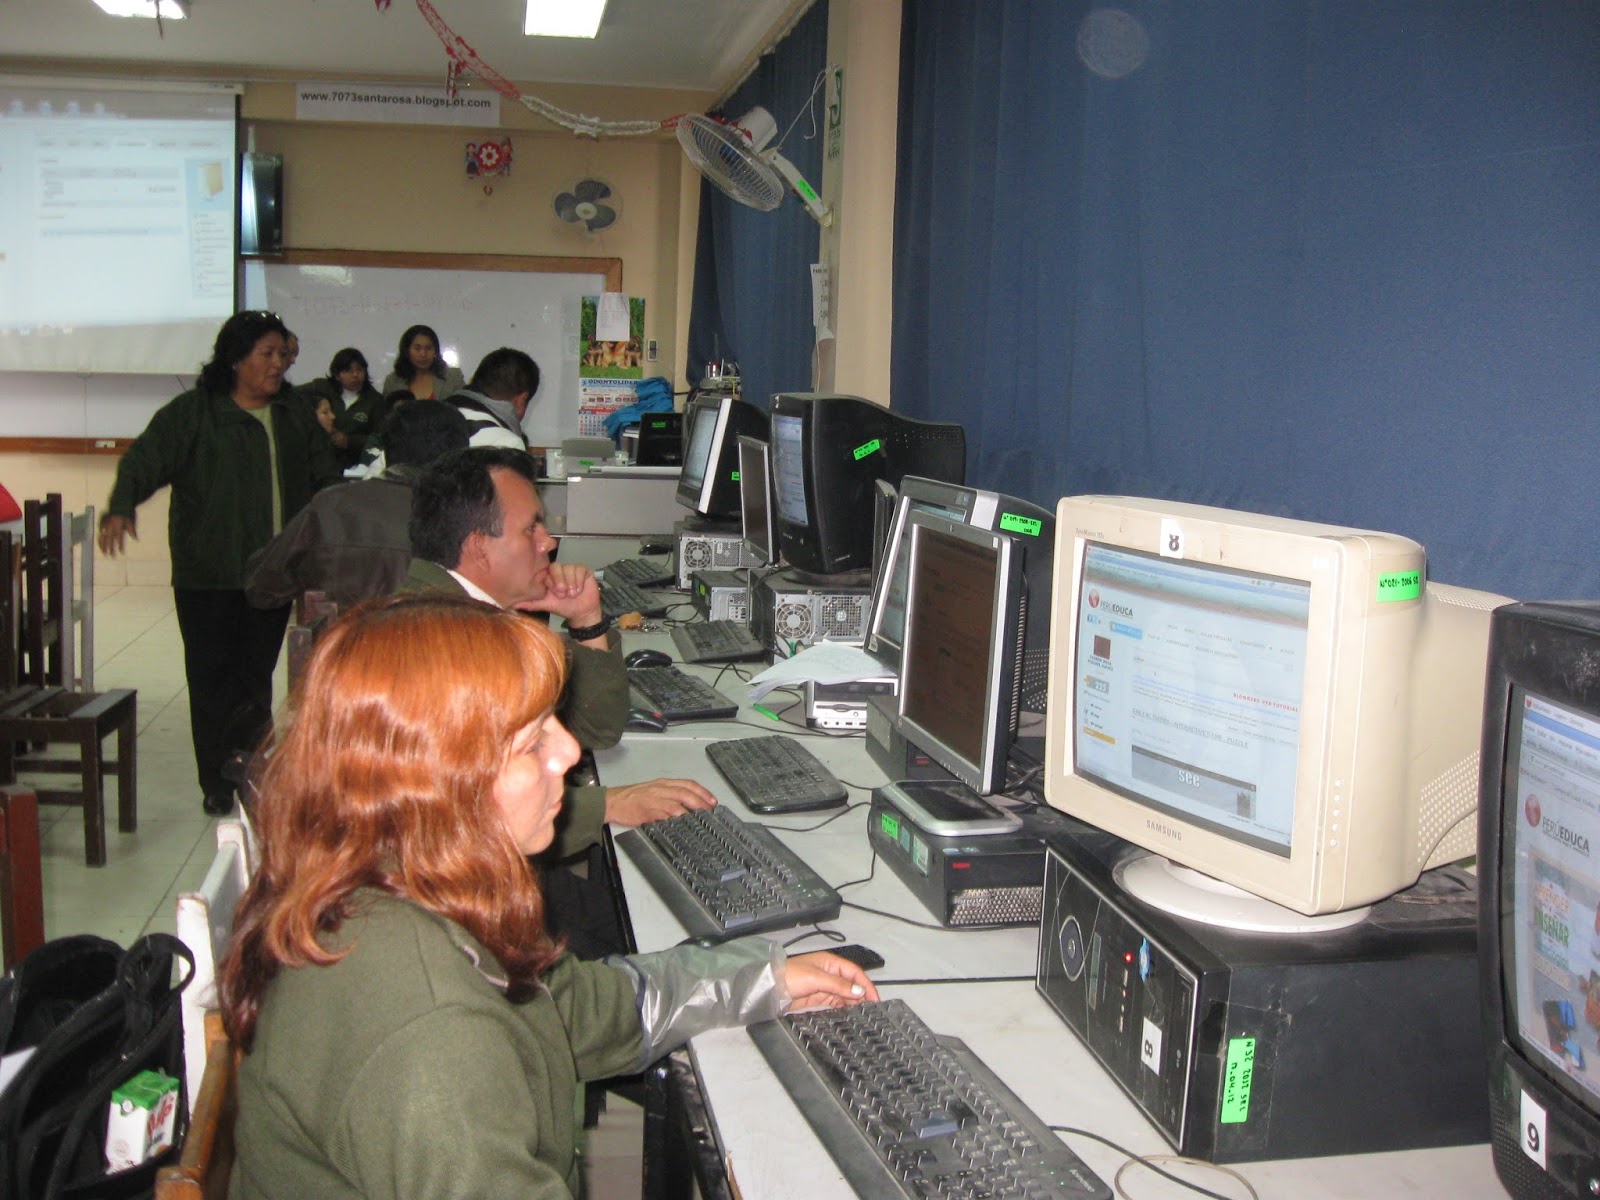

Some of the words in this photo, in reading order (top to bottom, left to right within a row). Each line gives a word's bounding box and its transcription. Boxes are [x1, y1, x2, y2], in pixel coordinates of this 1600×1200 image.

[1146, 819, 1182, 841] SAMSUNG
[1144, 1038, 1153, 1059] 8
[1527, 1122, 1540, 1152] 9
